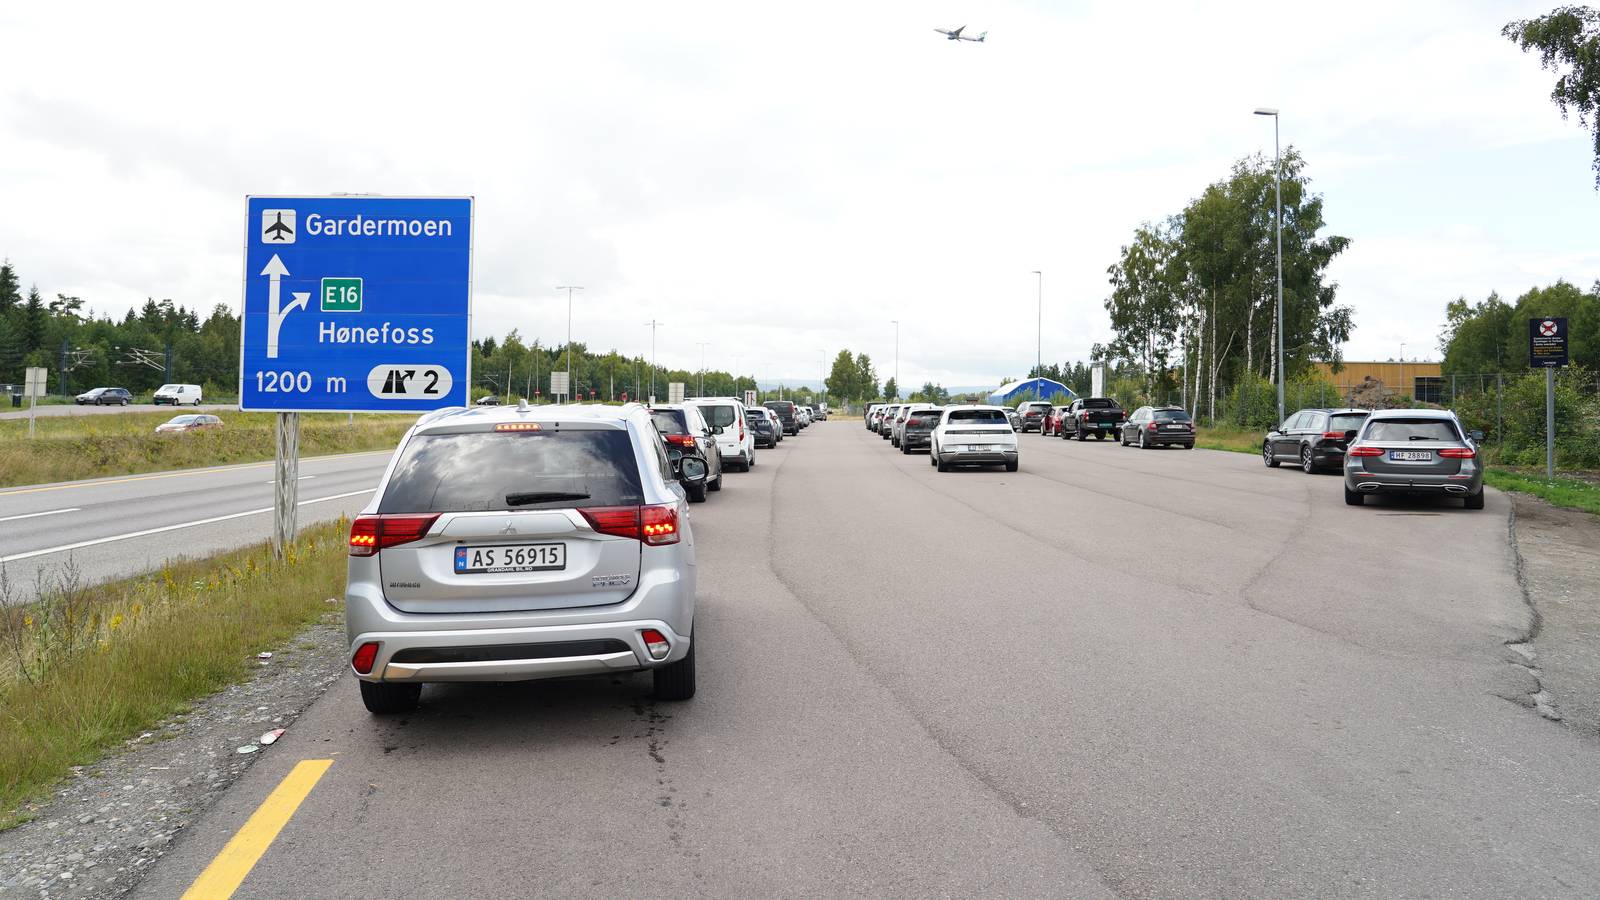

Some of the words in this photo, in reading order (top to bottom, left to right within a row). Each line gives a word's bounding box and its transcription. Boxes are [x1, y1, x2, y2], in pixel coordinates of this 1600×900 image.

[306, 213, 452, 236] Gardermoen
[319, 322, 434, 343] Hønefoss
[257, 371, 312, 392] 1200
[326, 376, 346, 392] m
[423, 370, 439, 394] 2
[472, 549, 494, 567] AS
[503, 547, 558, 566] 56915
